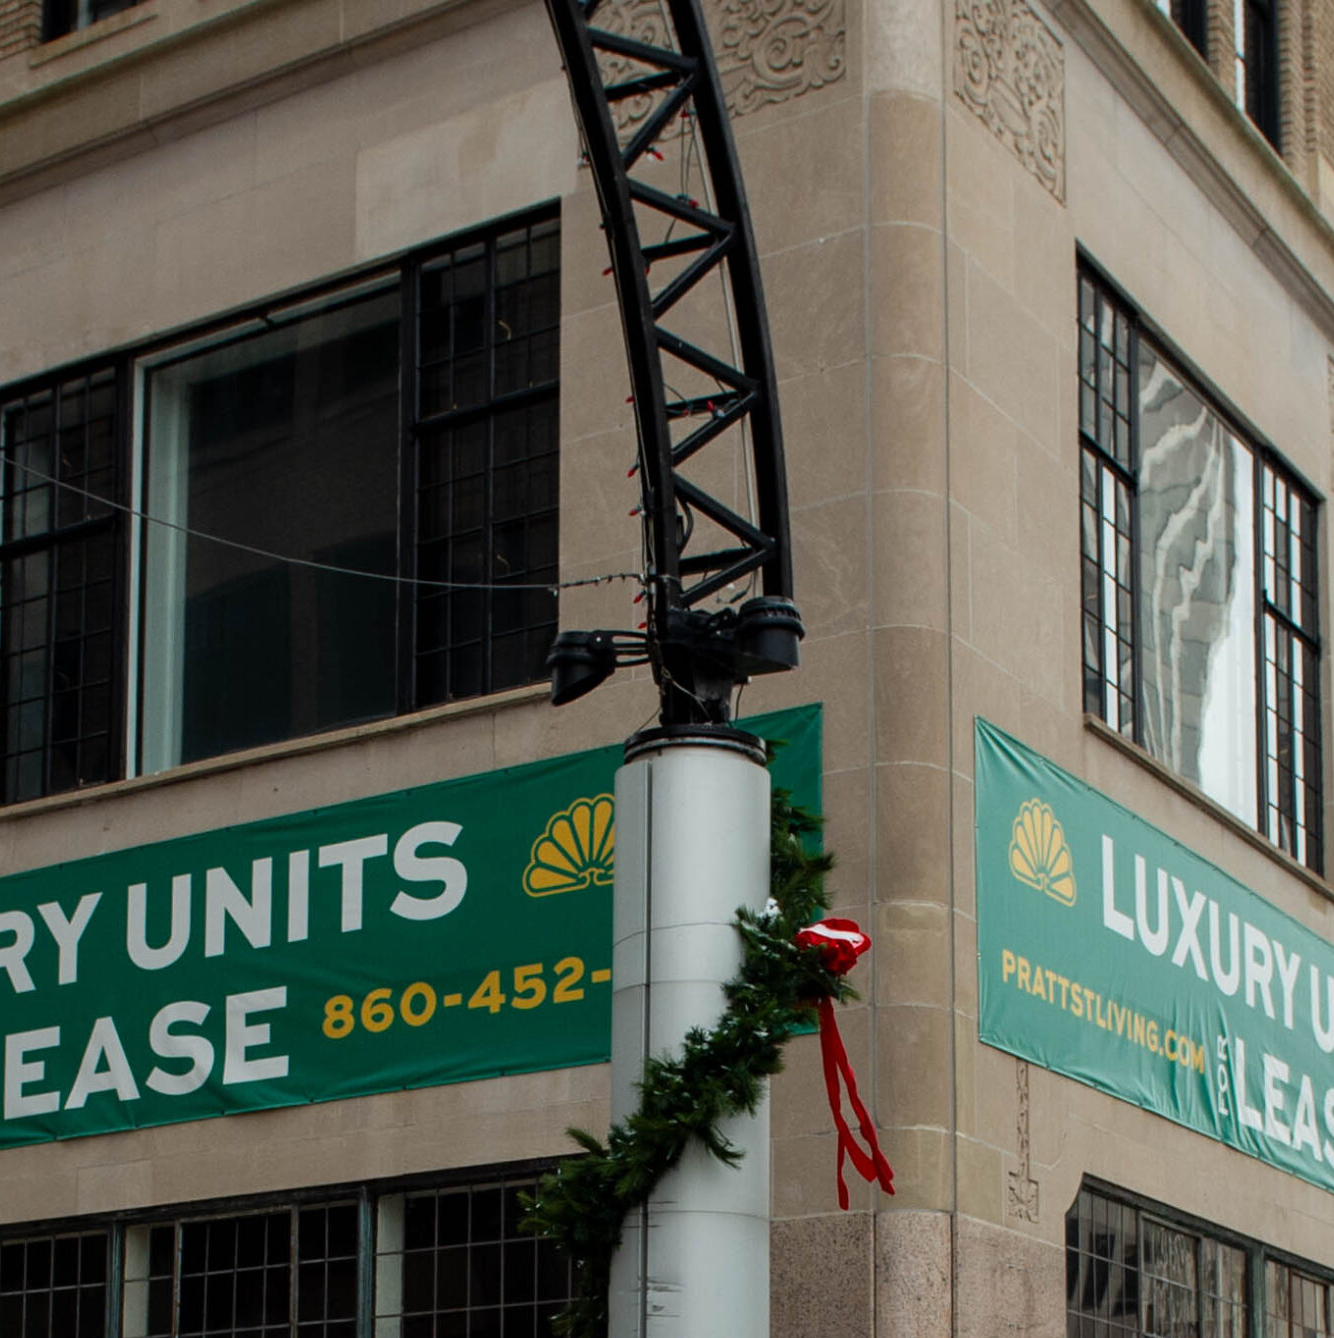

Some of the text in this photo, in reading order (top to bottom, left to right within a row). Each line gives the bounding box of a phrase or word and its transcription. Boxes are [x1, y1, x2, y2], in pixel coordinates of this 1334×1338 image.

[126, 820, 469, 971] UNITS
[1100, 833, 1302, 1032] LUXURY
[1001, 949, 1205, 1075] PRATTSTLIVING.COM
[1217, 1034, 1229, 1116] FOR
